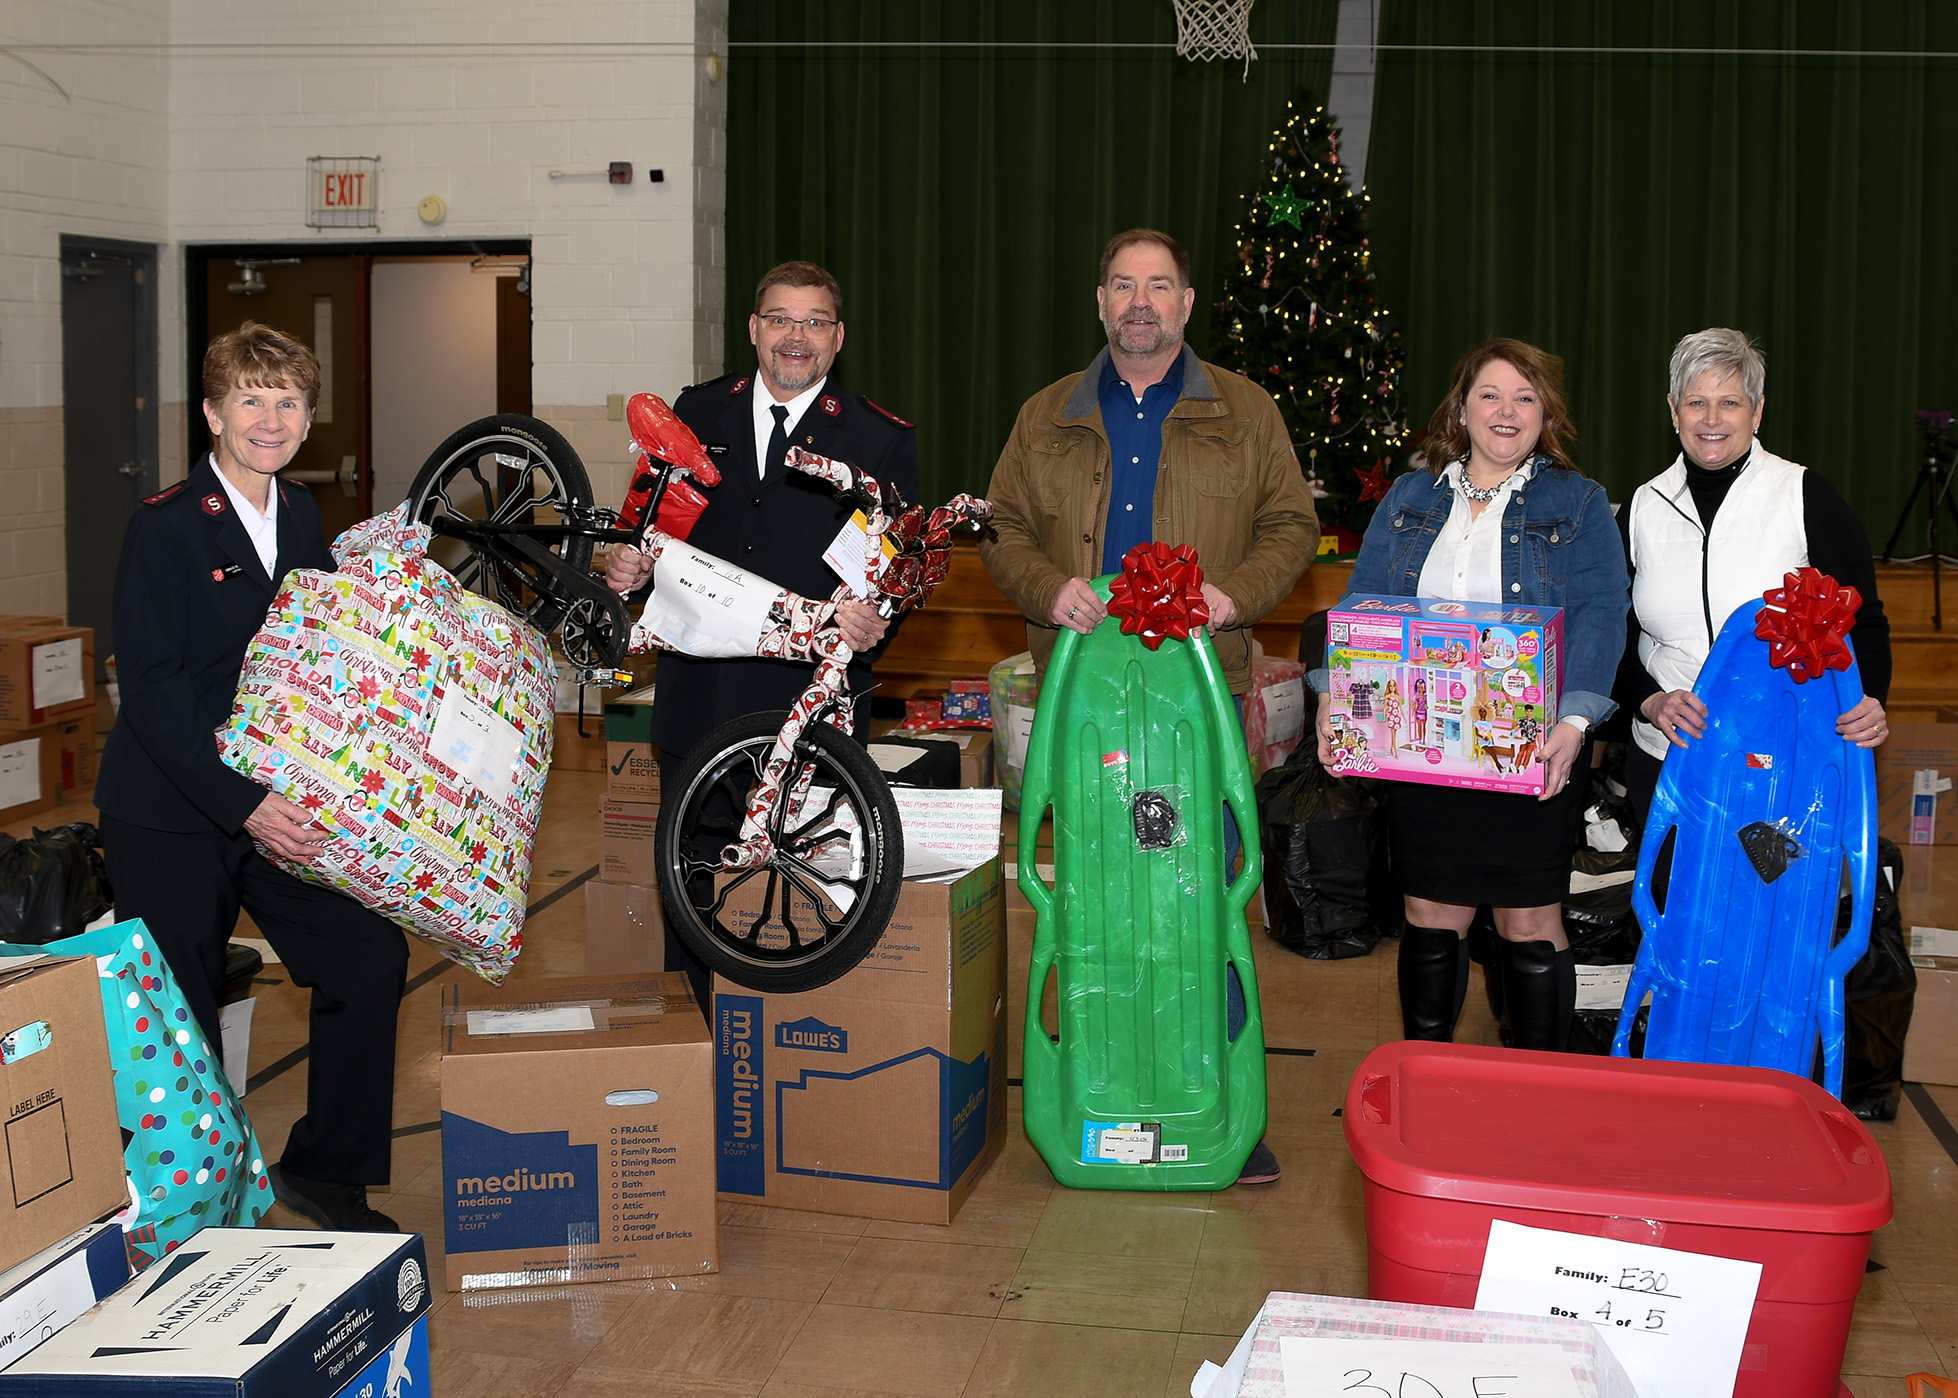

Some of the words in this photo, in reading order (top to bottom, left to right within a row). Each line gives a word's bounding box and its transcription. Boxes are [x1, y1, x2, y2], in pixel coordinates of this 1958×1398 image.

[326, 174, 364, 206] EXIT
[734, 379, 745, 392] S
[825, 399, 836, 413] S
[500, 425, 548, 451] mongoose
[207, 497, 221, 511] S
[691, 554, 716, 572] Family:
[339, 565, 378, 587] NOW
[679, 577, 693, 589] Box
[708, 591, 717, 600] of
[306, 704, 344, 732] CHRISTMAS
[280, 721, 334, 760] JOLLY
[366, 740, 412, 775] JOLLY
[630, 758, 660, 768] ESSE
[1332, 748, 1380, 773] Barbie
[283, 763, 339, 806] Christmas
[333, 810, 367, 838] CHRISTMAS
[415, 806, 455, 838] JOLLY
[872, 806, 887, 885] mongoose
[331, 837, 399, 886] HOLIDAY
[343, 863, 386, 892] SNOW
[764, 932, 785, 940] Room
[722, 1009, 732, 1056] mediana
[782, 1027, 841, 1049] LOWE'S
[733, 1010, 759, 1138] medium
[10, 1098, 35, 1117] LABEL
[35, 1088, 56, 1108] HERE
[620, 1125, 658, 1135] FRAGILE
[621, 1136, 660, 1145] Bedroom
[621, 1147, 650, 1156] Family
[651, 1146, 677, 1154] Room
[621, 1159, 650, 1167] Dining
[651, 1157, 676, 1165] Room
[457, 1167, 574, 1195] medium
[621, 1169, 656, 1178] Kitchen
[622, 1180, 643, 1189] Bath
[457, 1195, 512, 1207] mediana
[622, 1190, 666, 1199] Basement
[622, 1202, 644, 1210] Attic
[622, 1211, 660, 1221] Laundry
[464, 1223, 476, 1231] CU
[477, 1222, 487, 1230] FT
[622, 1223, 657, 1232] Garage
[631, 1233, 654, 1242] Load
[655, 1232, 664, 1240] of
[666, 1231, 693, 1239] Bricks
[1555, 1264, 1609, 1284] Family:
[141, 1252, 270, 1340] HAMMERMILL
[205, 1297, 248, 1323] Paper
[239, 1282, 266, 1296] for
[1550, 1307, 1578, 1322] Box
[1615, 1317, 1631, 1329] of
[1645, 1308, 1666, 1331] 5
[313, 1308, 375, 1363] HAMMERMILL
[328, 1356, 346, 1379] Paper
[345, 1349, 355, 1363] for
